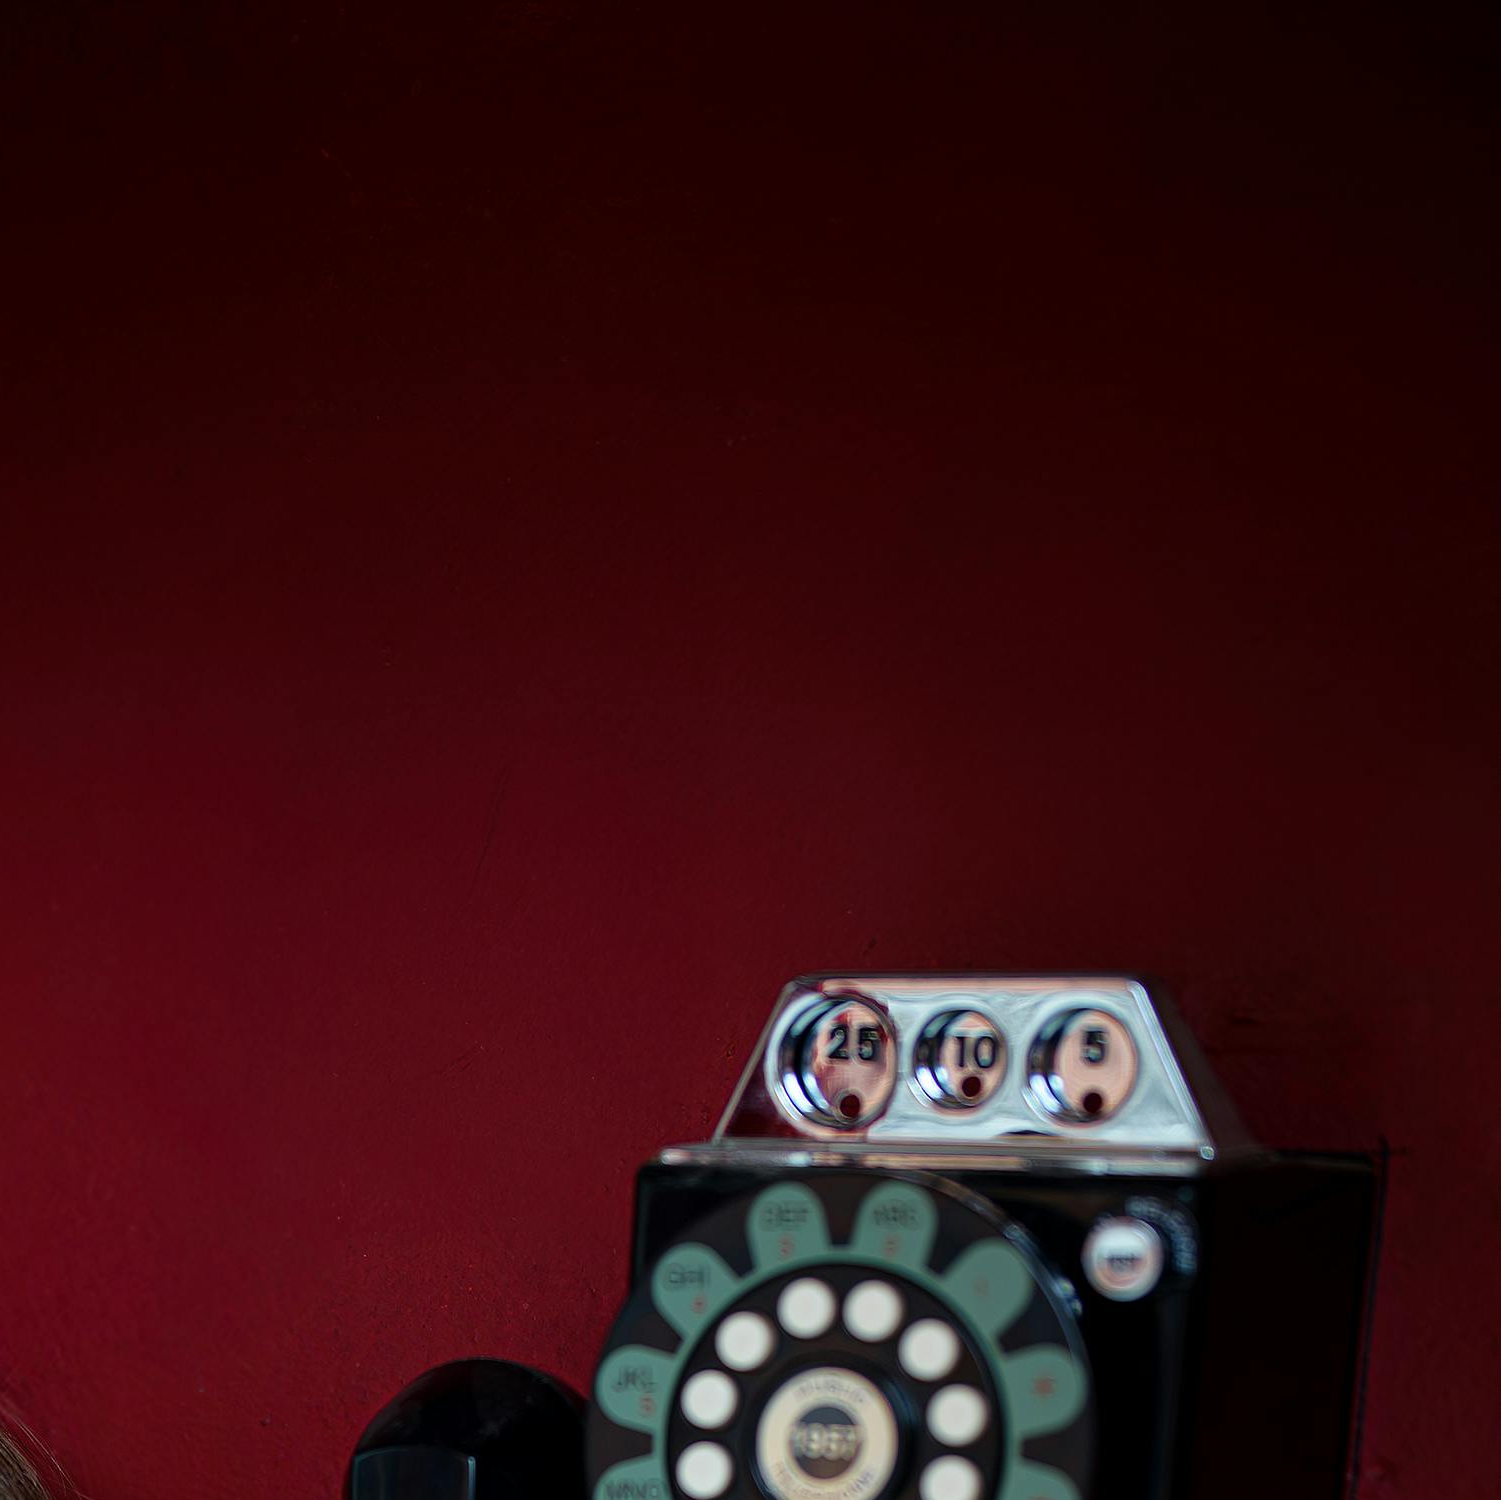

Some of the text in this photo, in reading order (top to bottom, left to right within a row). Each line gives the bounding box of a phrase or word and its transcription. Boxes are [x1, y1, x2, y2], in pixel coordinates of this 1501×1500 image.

[829, 1023, 882, 1061] 25
[953, 1035, 997, 1069] 10
[1080, 1026, 1109, 1064] 5
